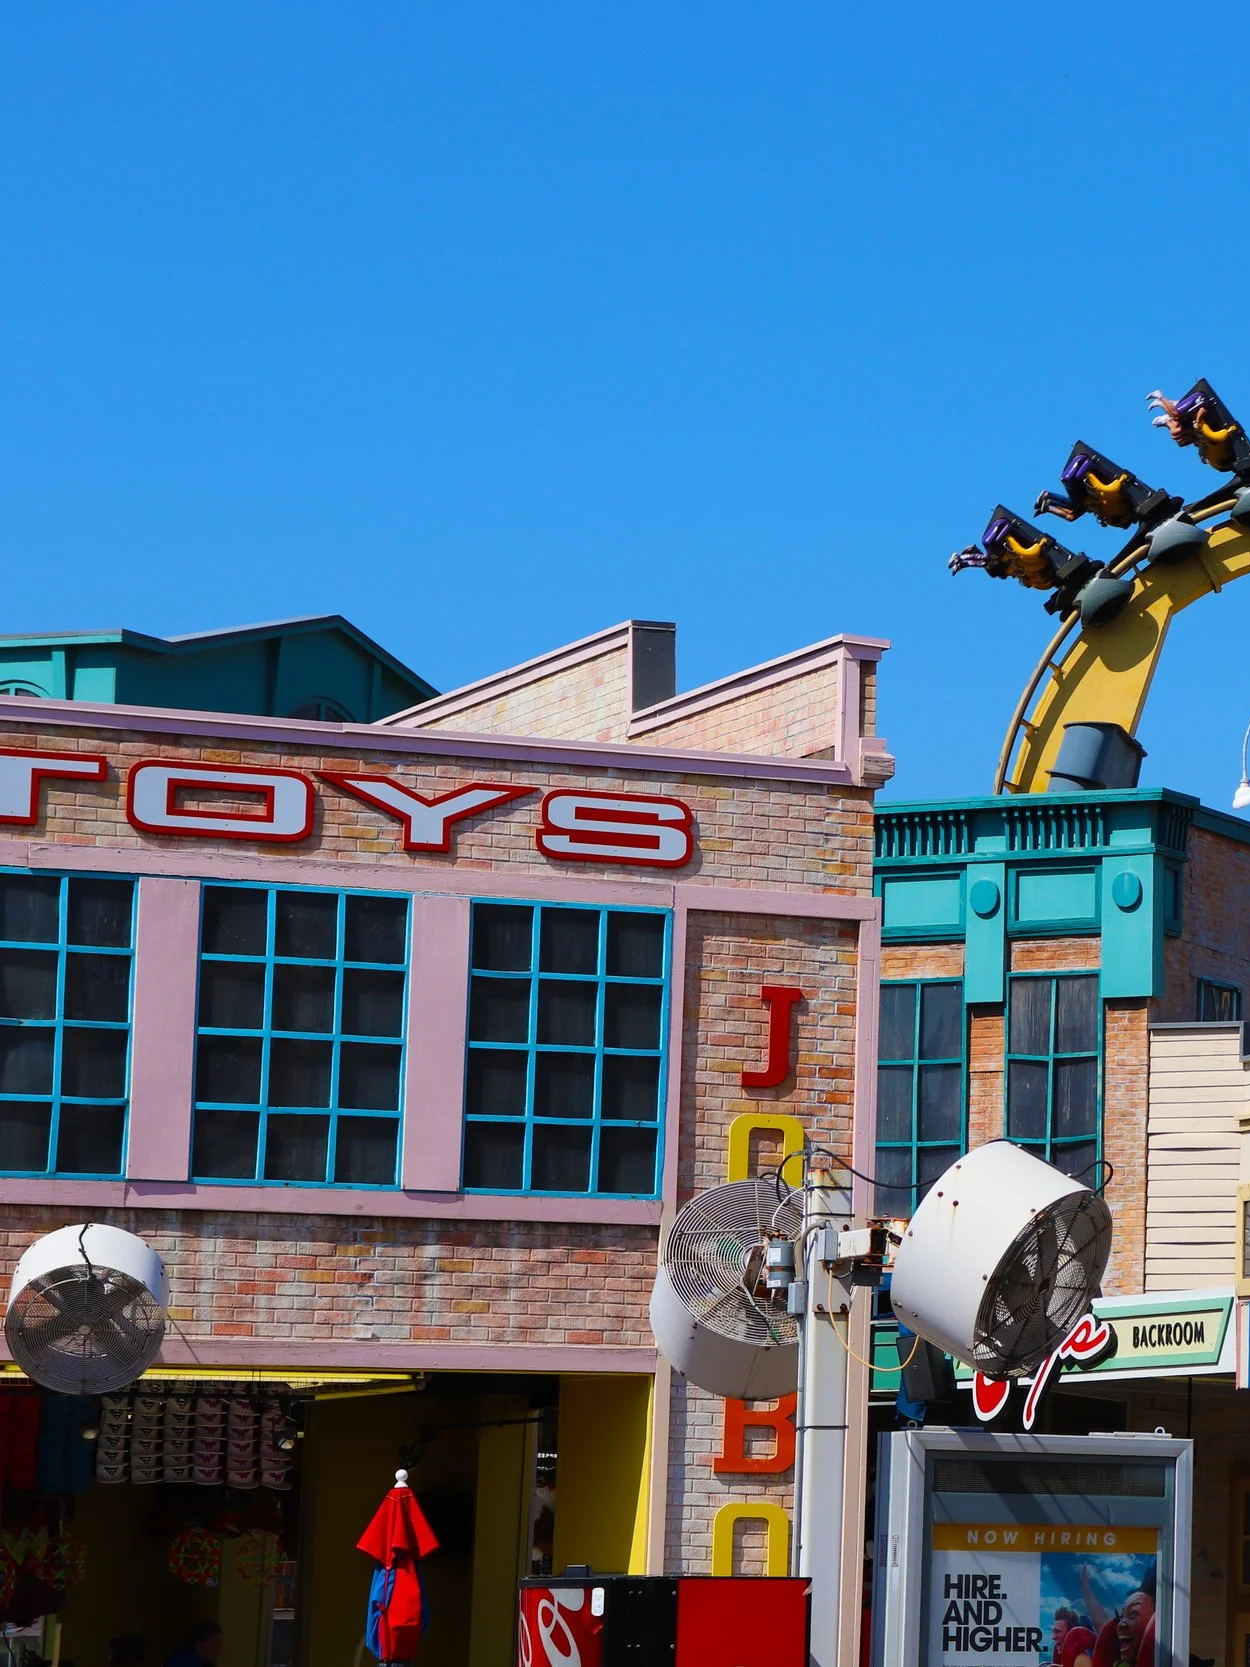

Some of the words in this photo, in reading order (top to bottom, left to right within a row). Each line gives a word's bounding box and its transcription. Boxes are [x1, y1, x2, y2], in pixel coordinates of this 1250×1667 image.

[1132, 1321, 1205, 1348] BACKROOM
[967, 1530, 1019, 1545] NOW
[1034, 1531, 1118, 1546] HIRING
[944, 1573, 1007, 1600] HIRE.
[942, 1600, 1003, 1626] AND
[942, 1626, 1049, 1653] HIGHER.
